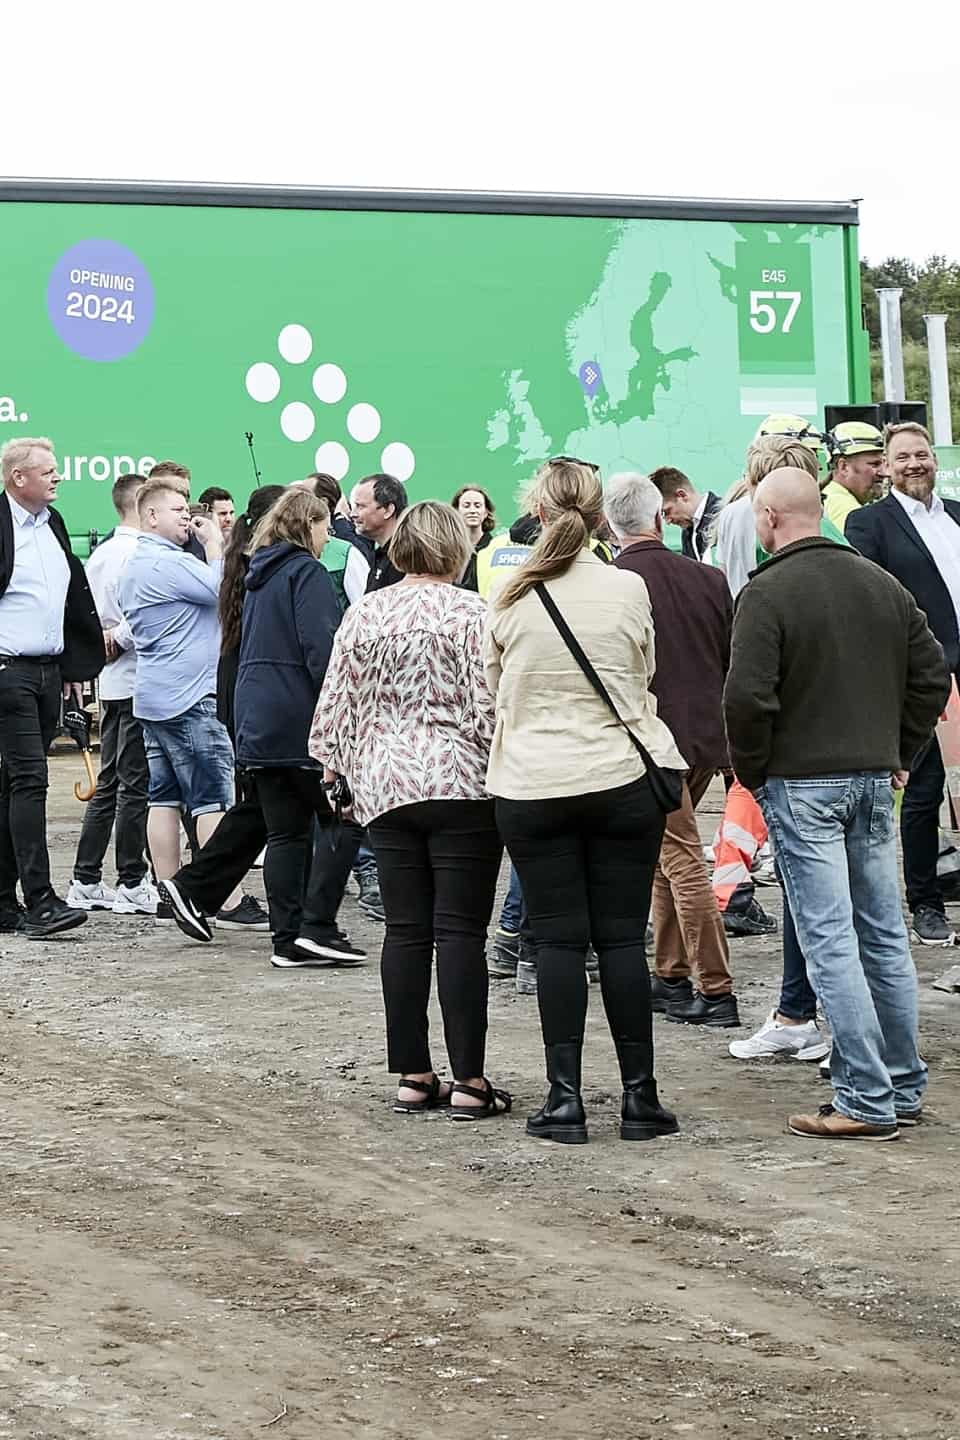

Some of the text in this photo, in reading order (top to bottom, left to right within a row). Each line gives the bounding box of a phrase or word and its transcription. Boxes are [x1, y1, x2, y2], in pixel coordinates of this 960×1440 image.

[70, 269, 135, 292] OPENING
[761, 269, 786, 283] E45
[66, 292, 135, 324] 2024
[749, 290, 802, 333] 57
